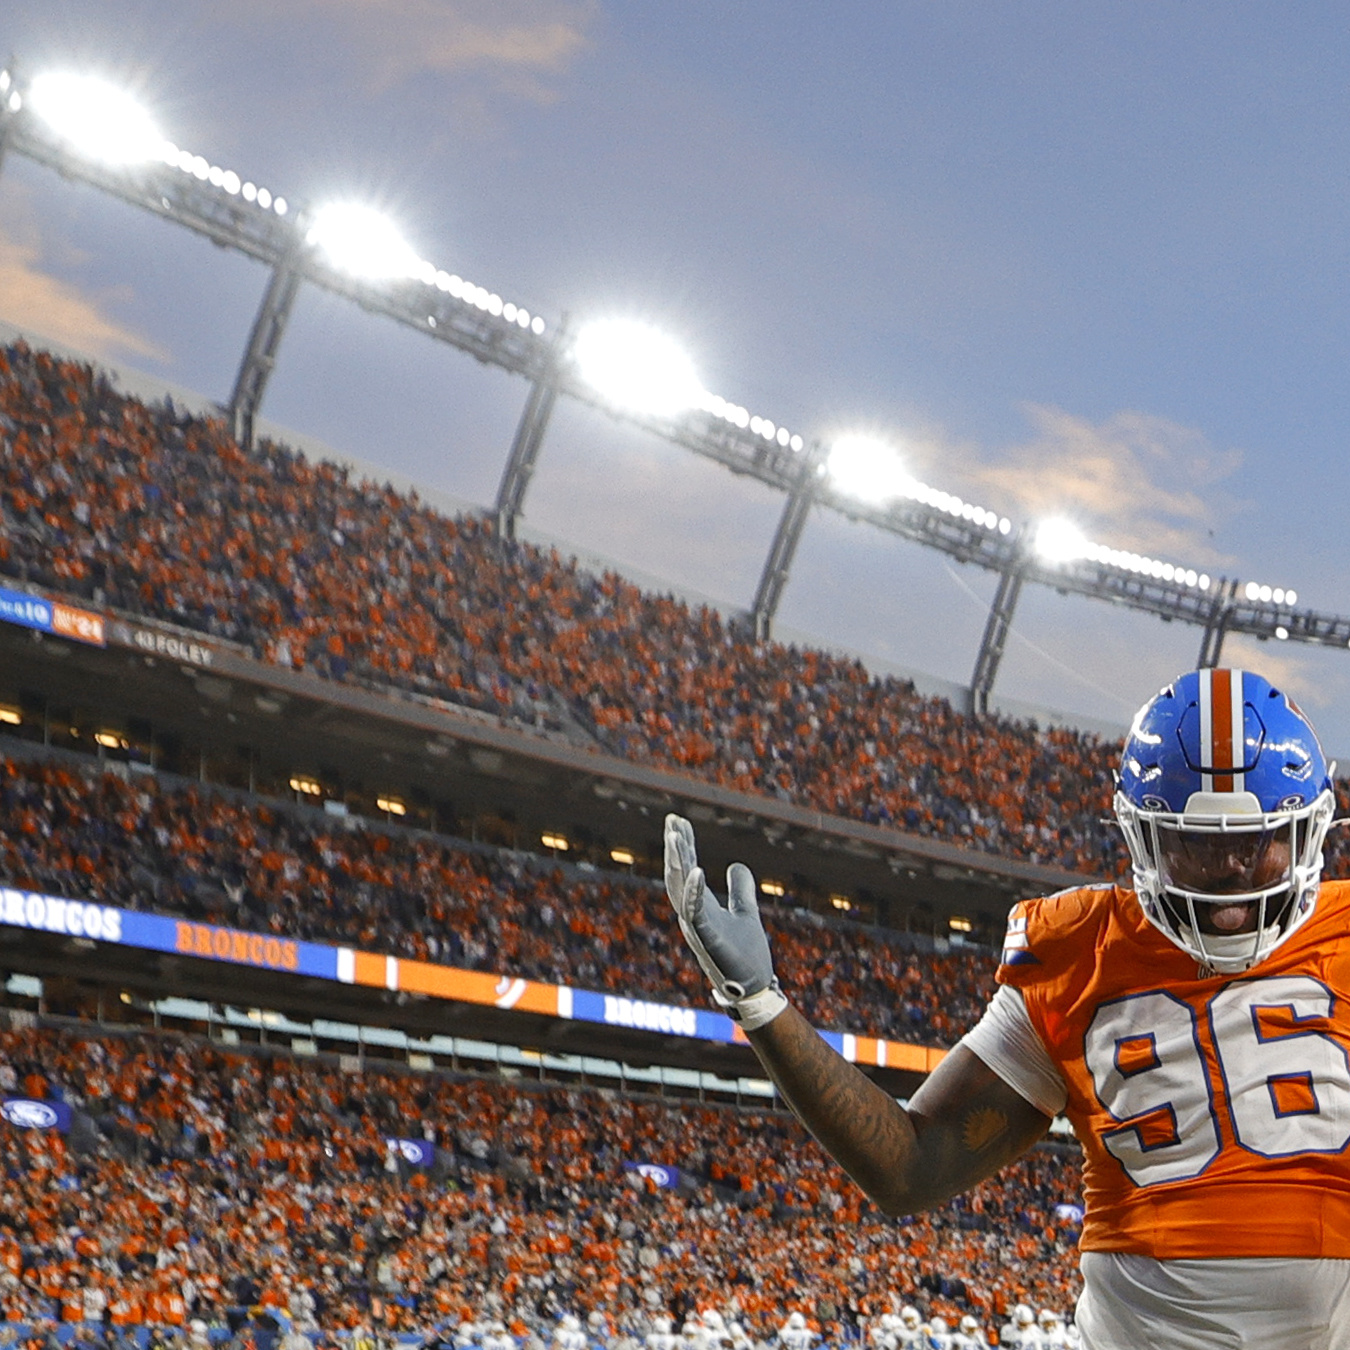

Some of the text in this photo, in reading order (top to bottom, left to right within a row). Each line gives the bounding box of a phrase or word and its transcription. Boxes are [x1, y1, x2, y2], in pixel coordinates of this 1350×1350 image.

[156, 634, 213, 666] FOLEY
[0, 888, 122, 943] RONCOS
[175, 920, 298, 971] BRONCOS
[604, 995, 697, 1036] BRONCOS
